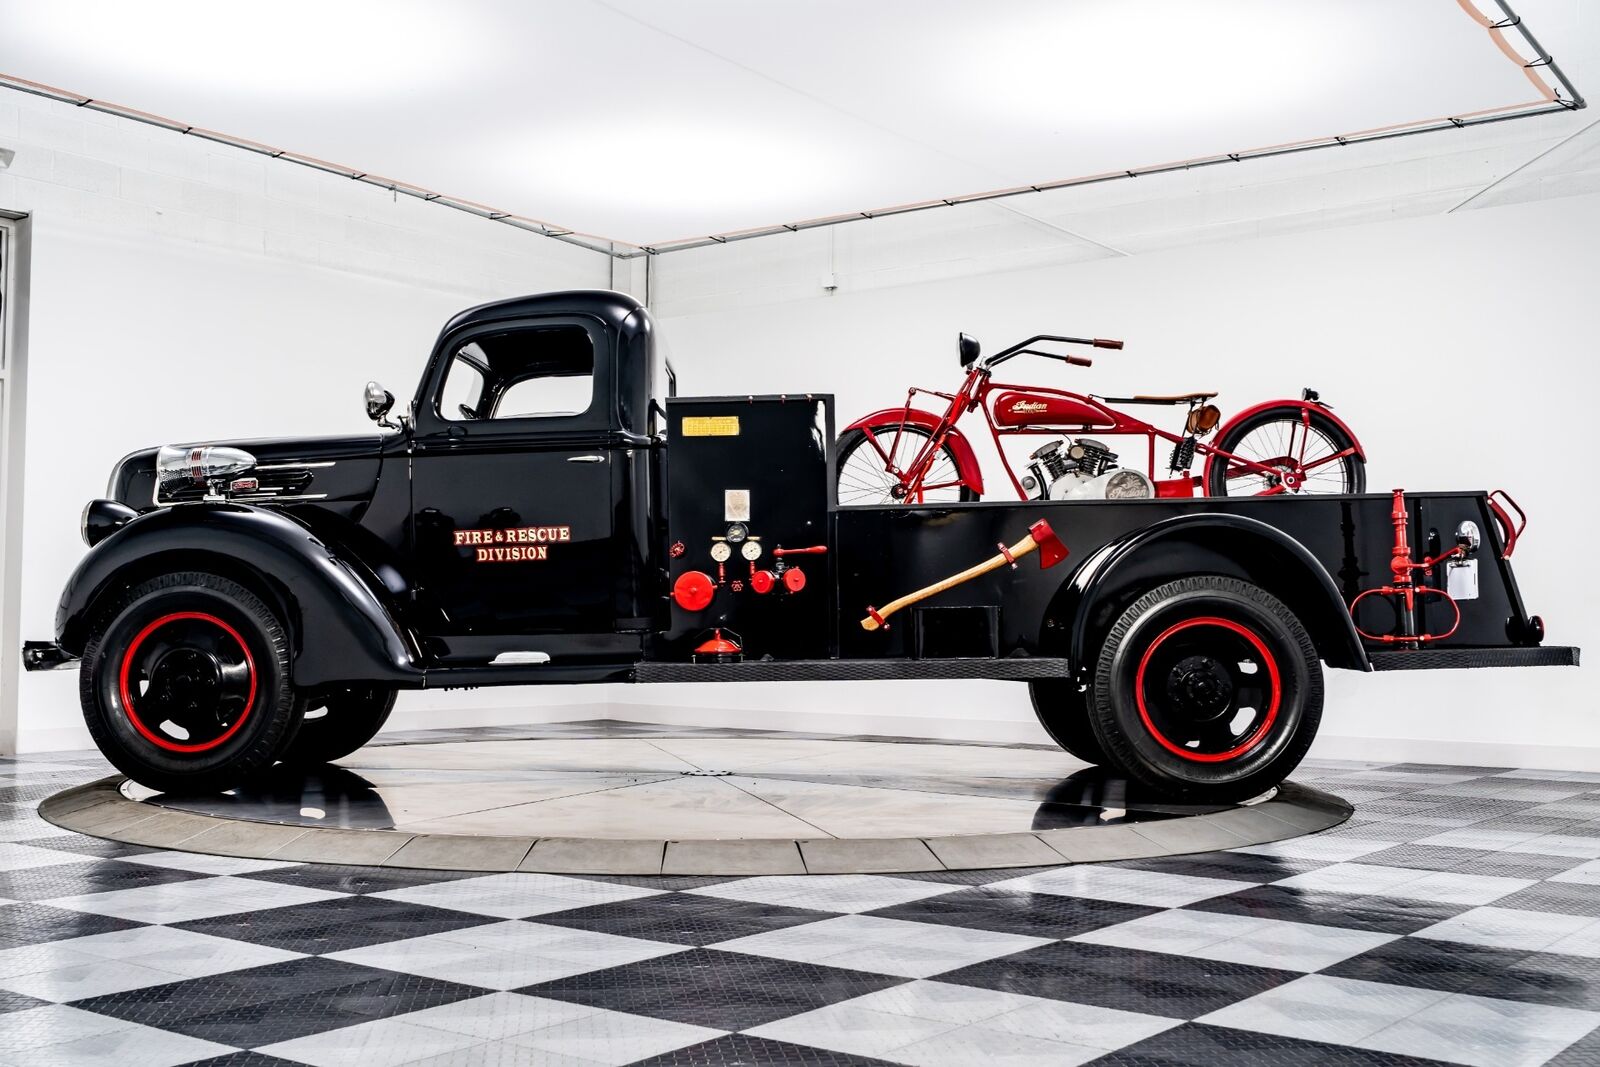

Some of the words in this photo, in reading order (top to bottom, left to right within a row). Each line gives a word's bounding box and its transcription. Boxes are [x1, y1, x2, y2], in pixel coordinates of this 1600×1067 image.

[1012, 400, 1047, 411] Indian
[454, 530, 493, 545] FIRE
[495, 531, 503, 542] &
[505, 526, 570, 543] RESCUE
[477, 546, 547, 561] DIVISION
